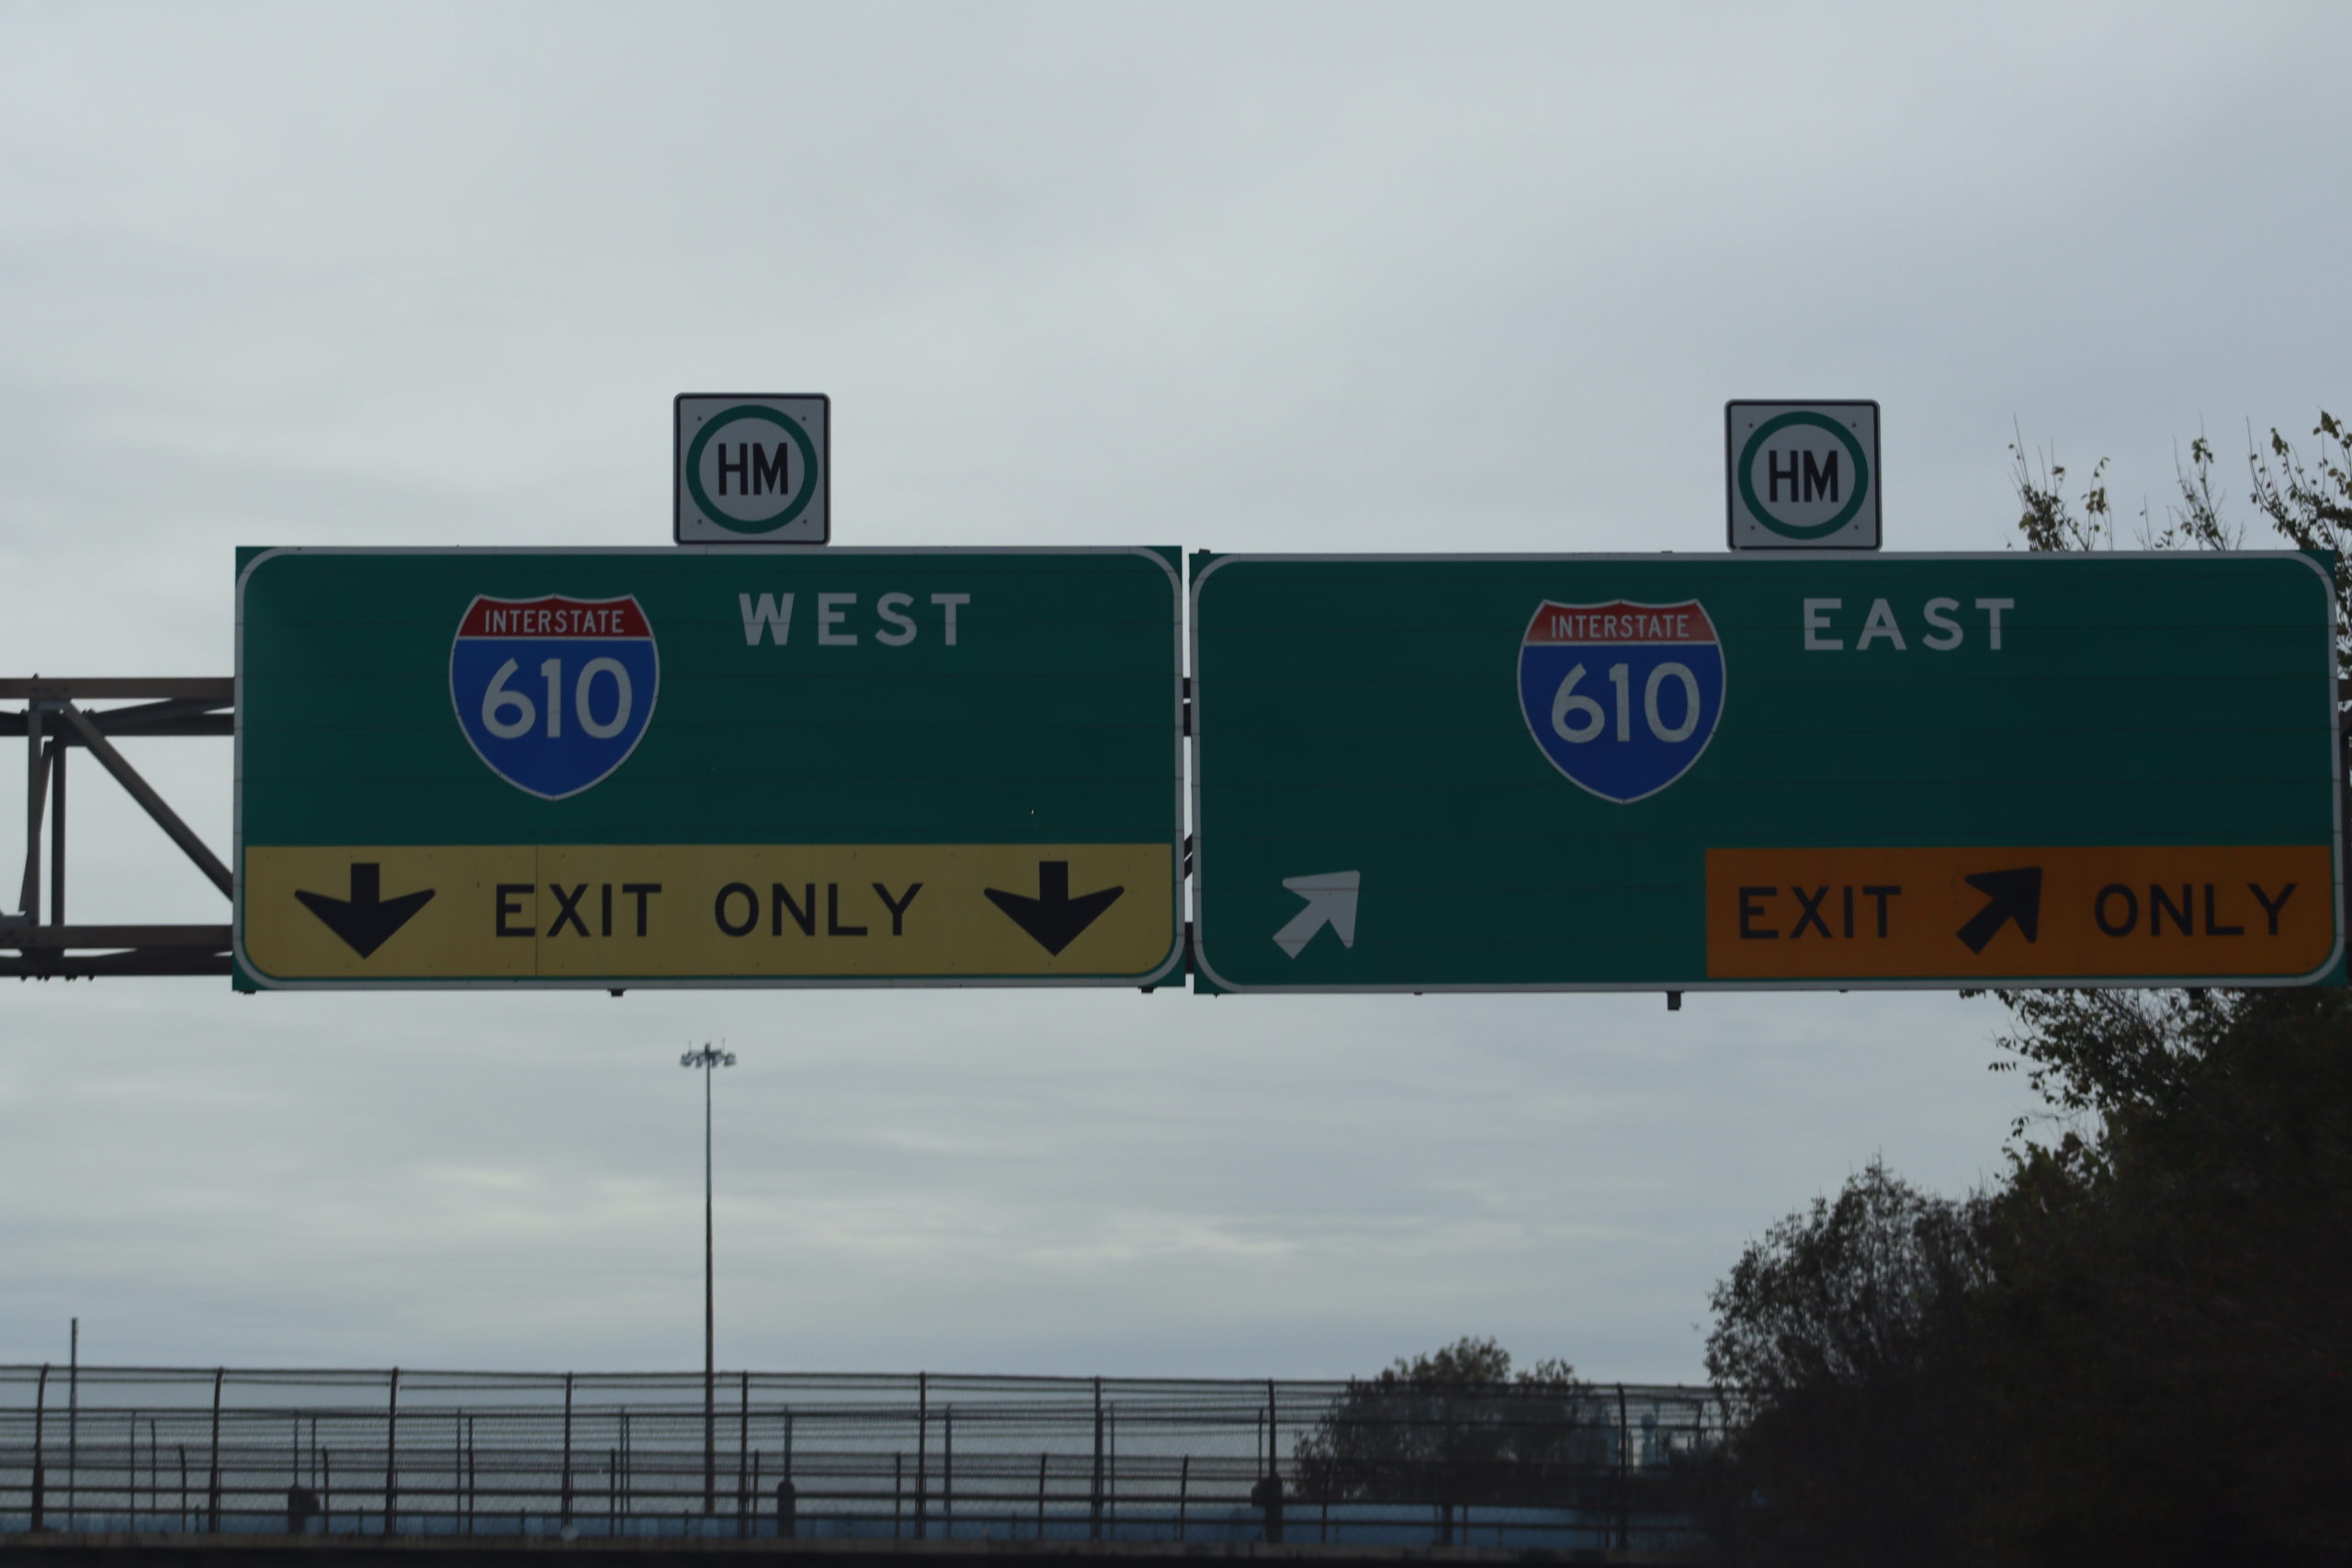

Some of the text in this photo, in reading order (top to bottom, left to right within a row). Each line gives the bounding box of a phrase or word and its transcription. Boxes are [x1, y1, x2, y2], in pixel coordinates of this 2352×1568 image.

[717, 443, 788, 495] HM
[1769, 450, 1838, 502] HM
[483, 608, 626, 635] INTERSTATE
[738, 592, 971, 647] WEST
[1550, 614, 1690, 640] INTERSTATE
[1803, 597, 2016, 651] EAST
[481, 656, 634, 740] 610
[1550, 661, 1701, 744] 610
[493, 882, 923, 938] EXIT ONLY
[1737, 882, 2298, 940] EXIT ONLY
